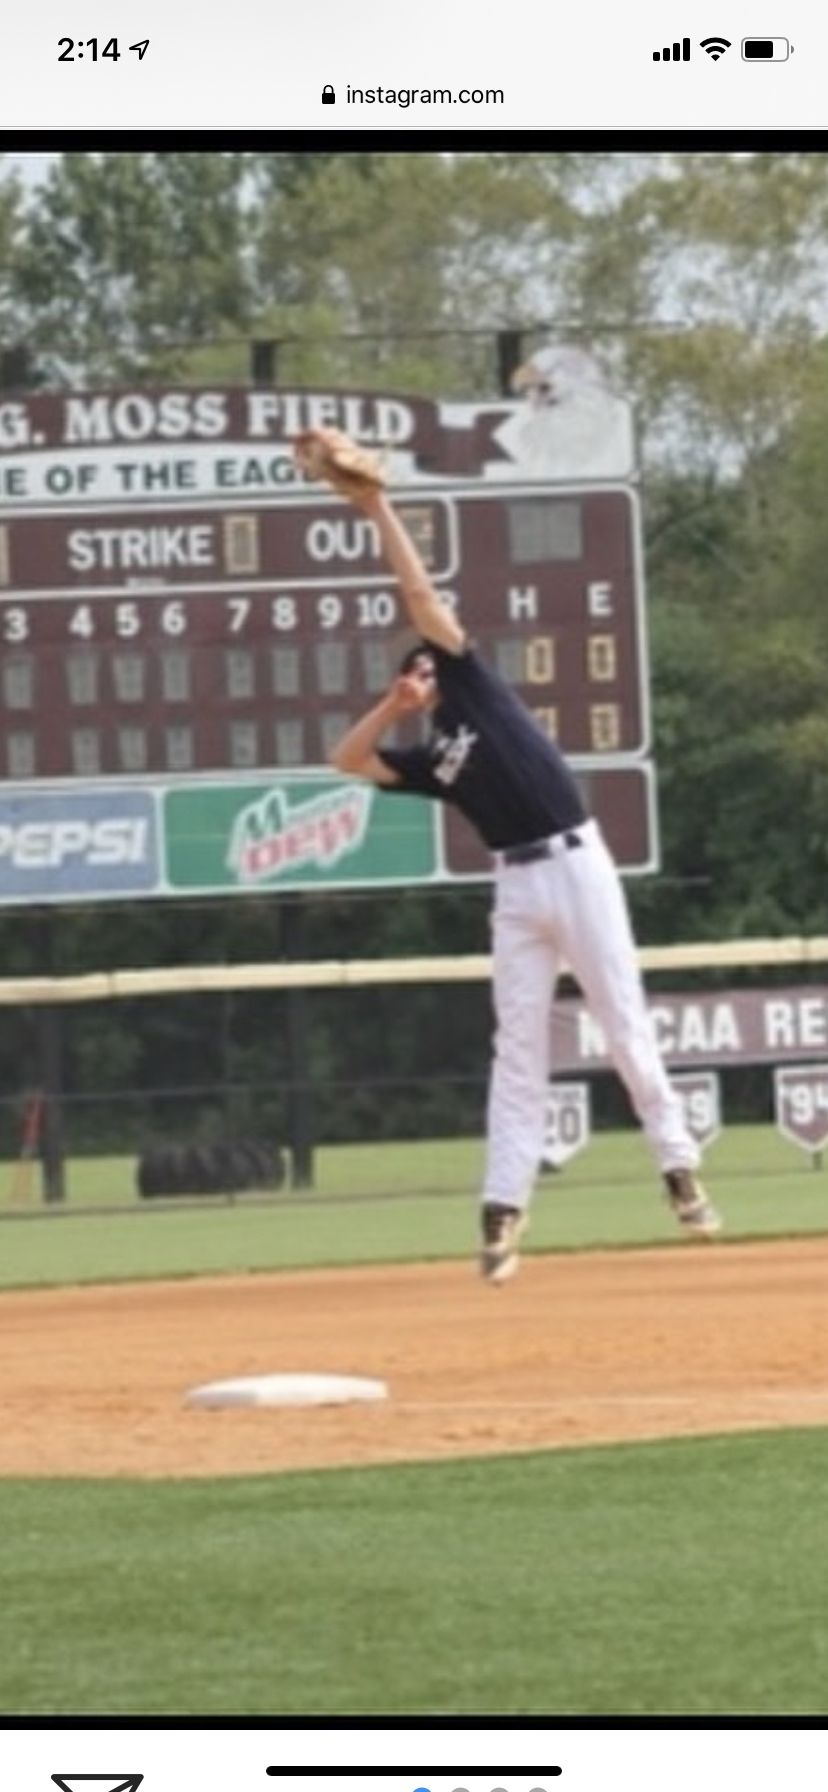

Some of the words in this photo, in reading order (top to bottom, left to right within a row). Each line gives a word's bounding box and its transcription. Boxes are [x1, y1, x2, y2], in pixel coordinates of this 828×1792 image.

[0, 402, 45, 448] G.
[64, 393, 231, 443] MOSS
[246, 392, 416, 444] FIELD
[44, 463, 99, 496] OF
[114, 459, 197, 493] THE
[67, 523, 214, 571] STRIKE
[4, 609, 29, 641] 3
[68, 605, 94, 638] 4
[115, 602, 141, 637] 5
[161, 600, 187, 634] 6
[227, 598, 250, 632] 7
[271, 596, 298, 630] 8
[316, 593, 342, 628] 9
[356, 592, 396, 627] 10
[508, 586, 537, 621] H
[587, 581, 613, 618] E
